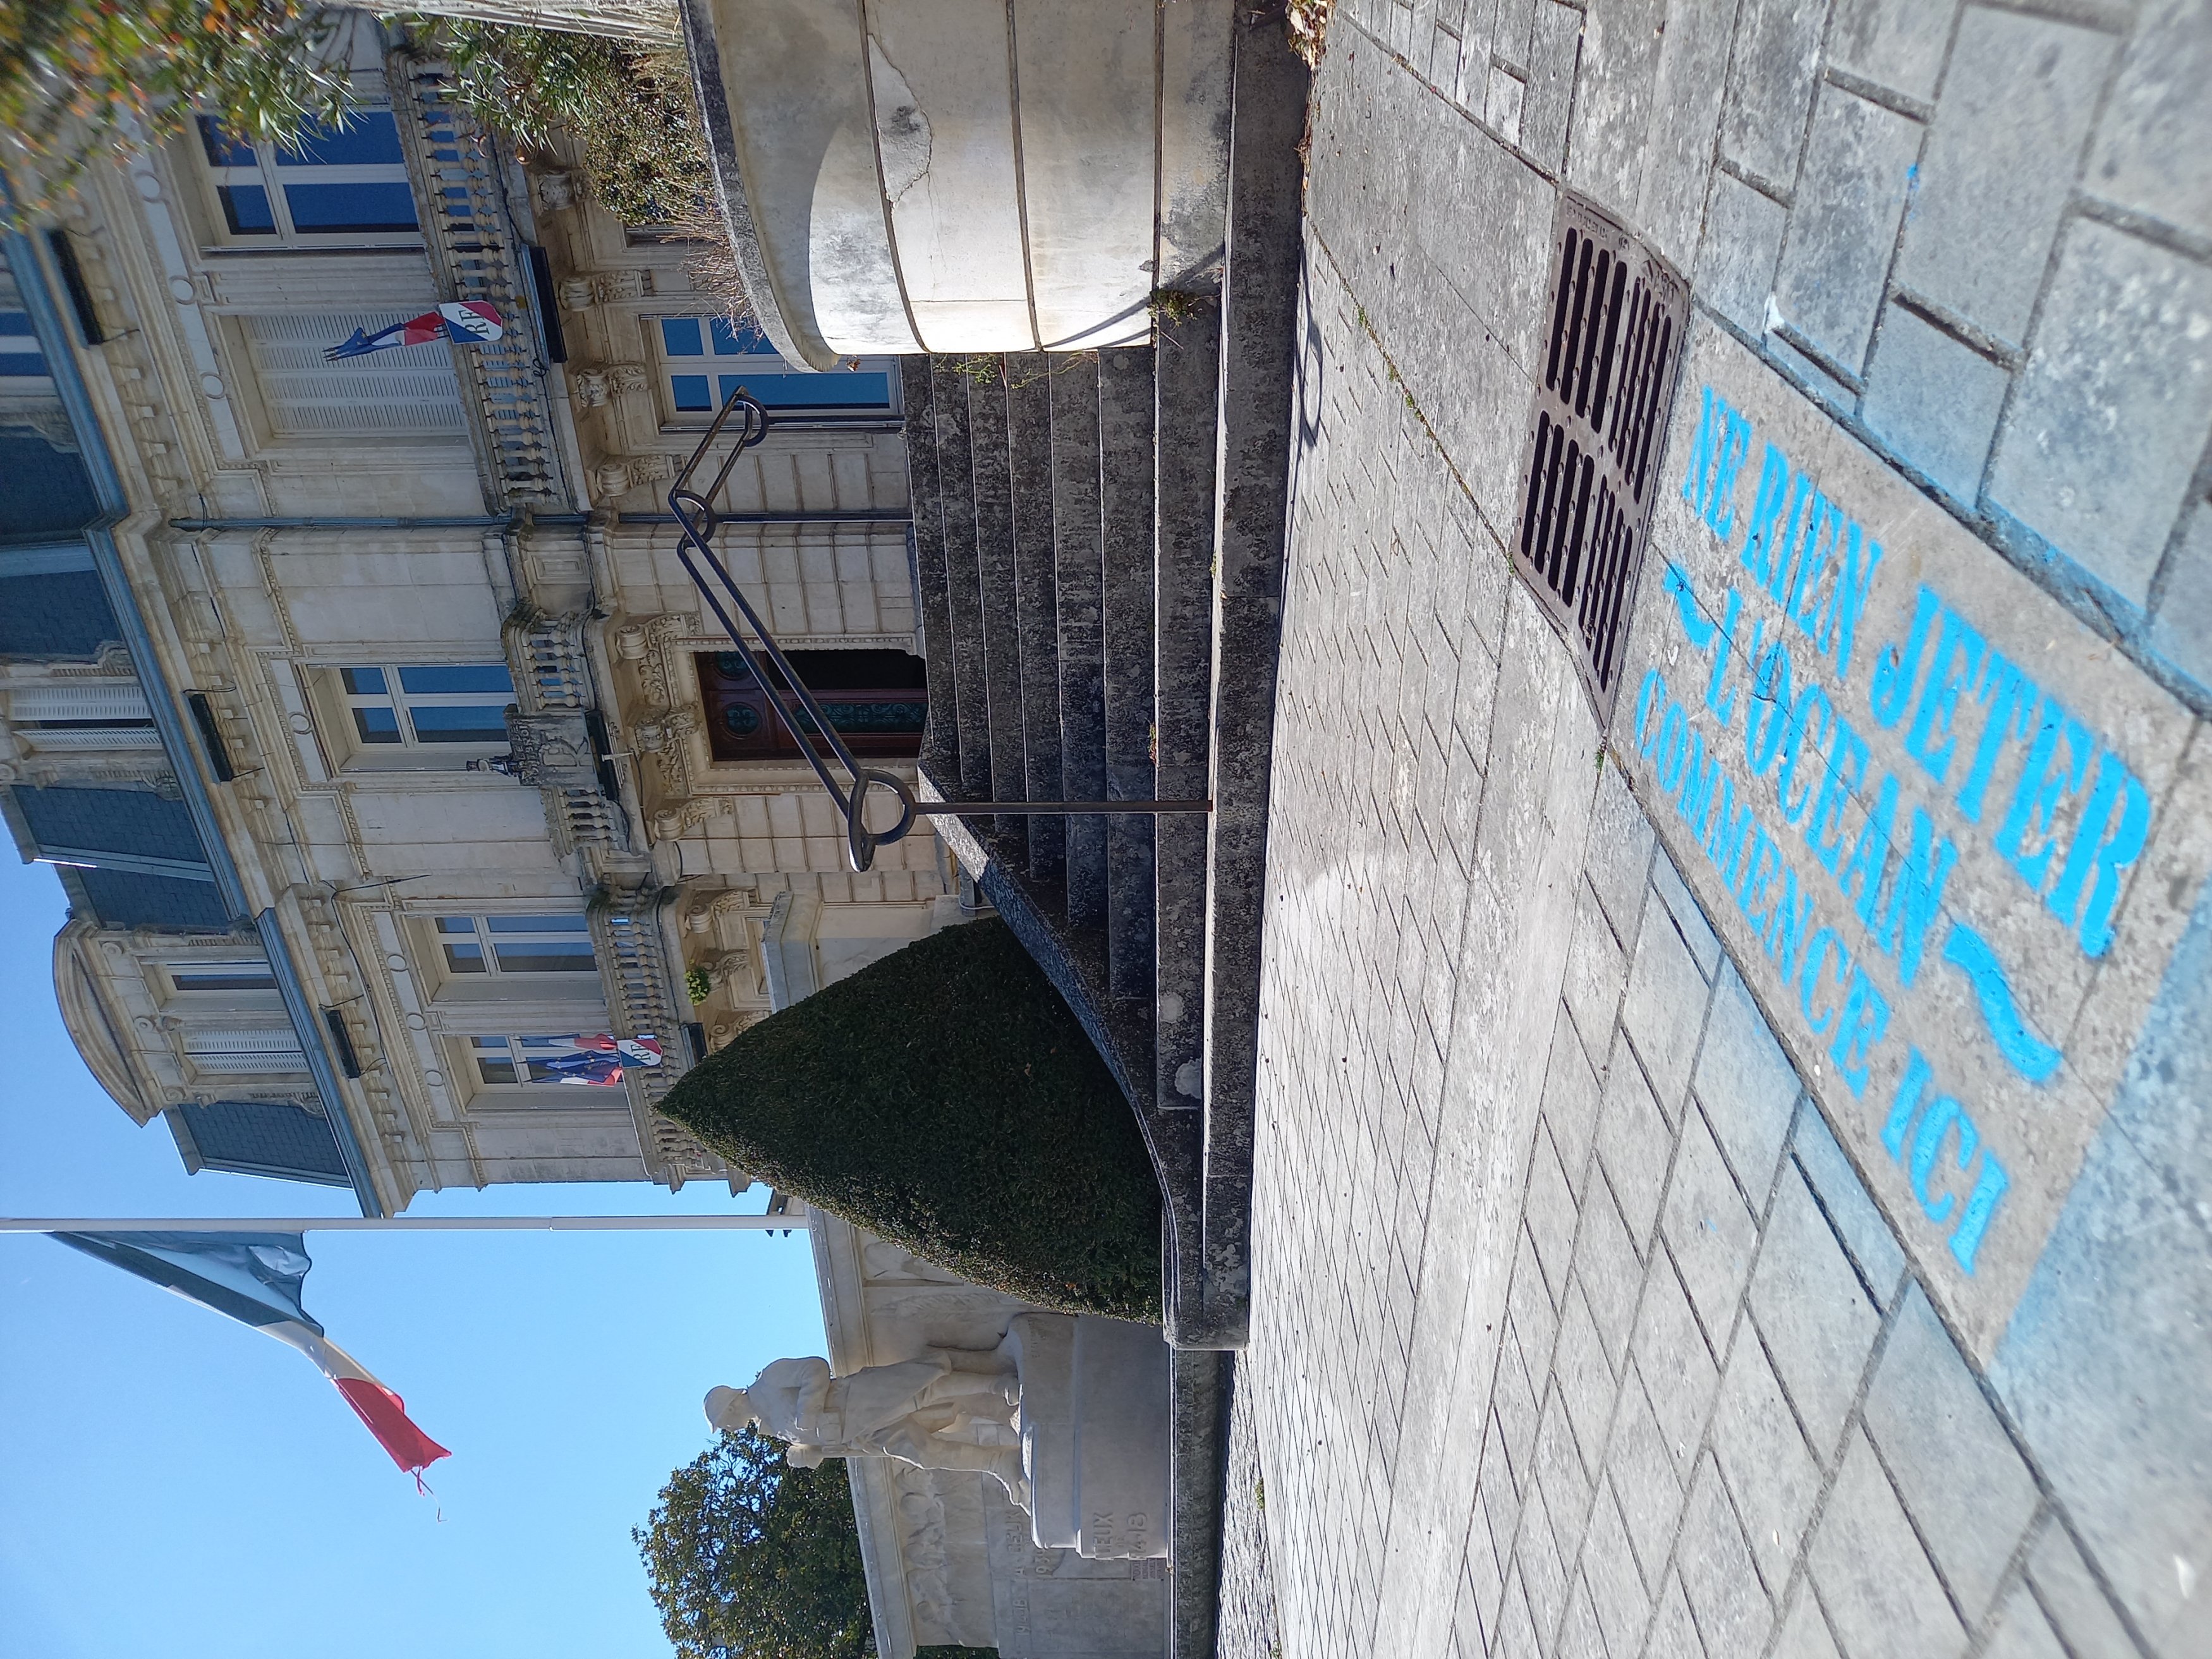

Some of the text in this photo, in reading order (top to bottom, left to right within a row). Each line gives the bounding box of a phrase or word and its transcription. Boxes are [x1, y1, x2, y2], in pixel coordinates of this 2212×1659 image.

[458, 309, 490, 334] RF
[1682, 386, 2150, 958] NE RIEN JETER
[631, 1044, 652, 1061] RF
[1634, 669, 2010, 1275] COMMENCE ICI
